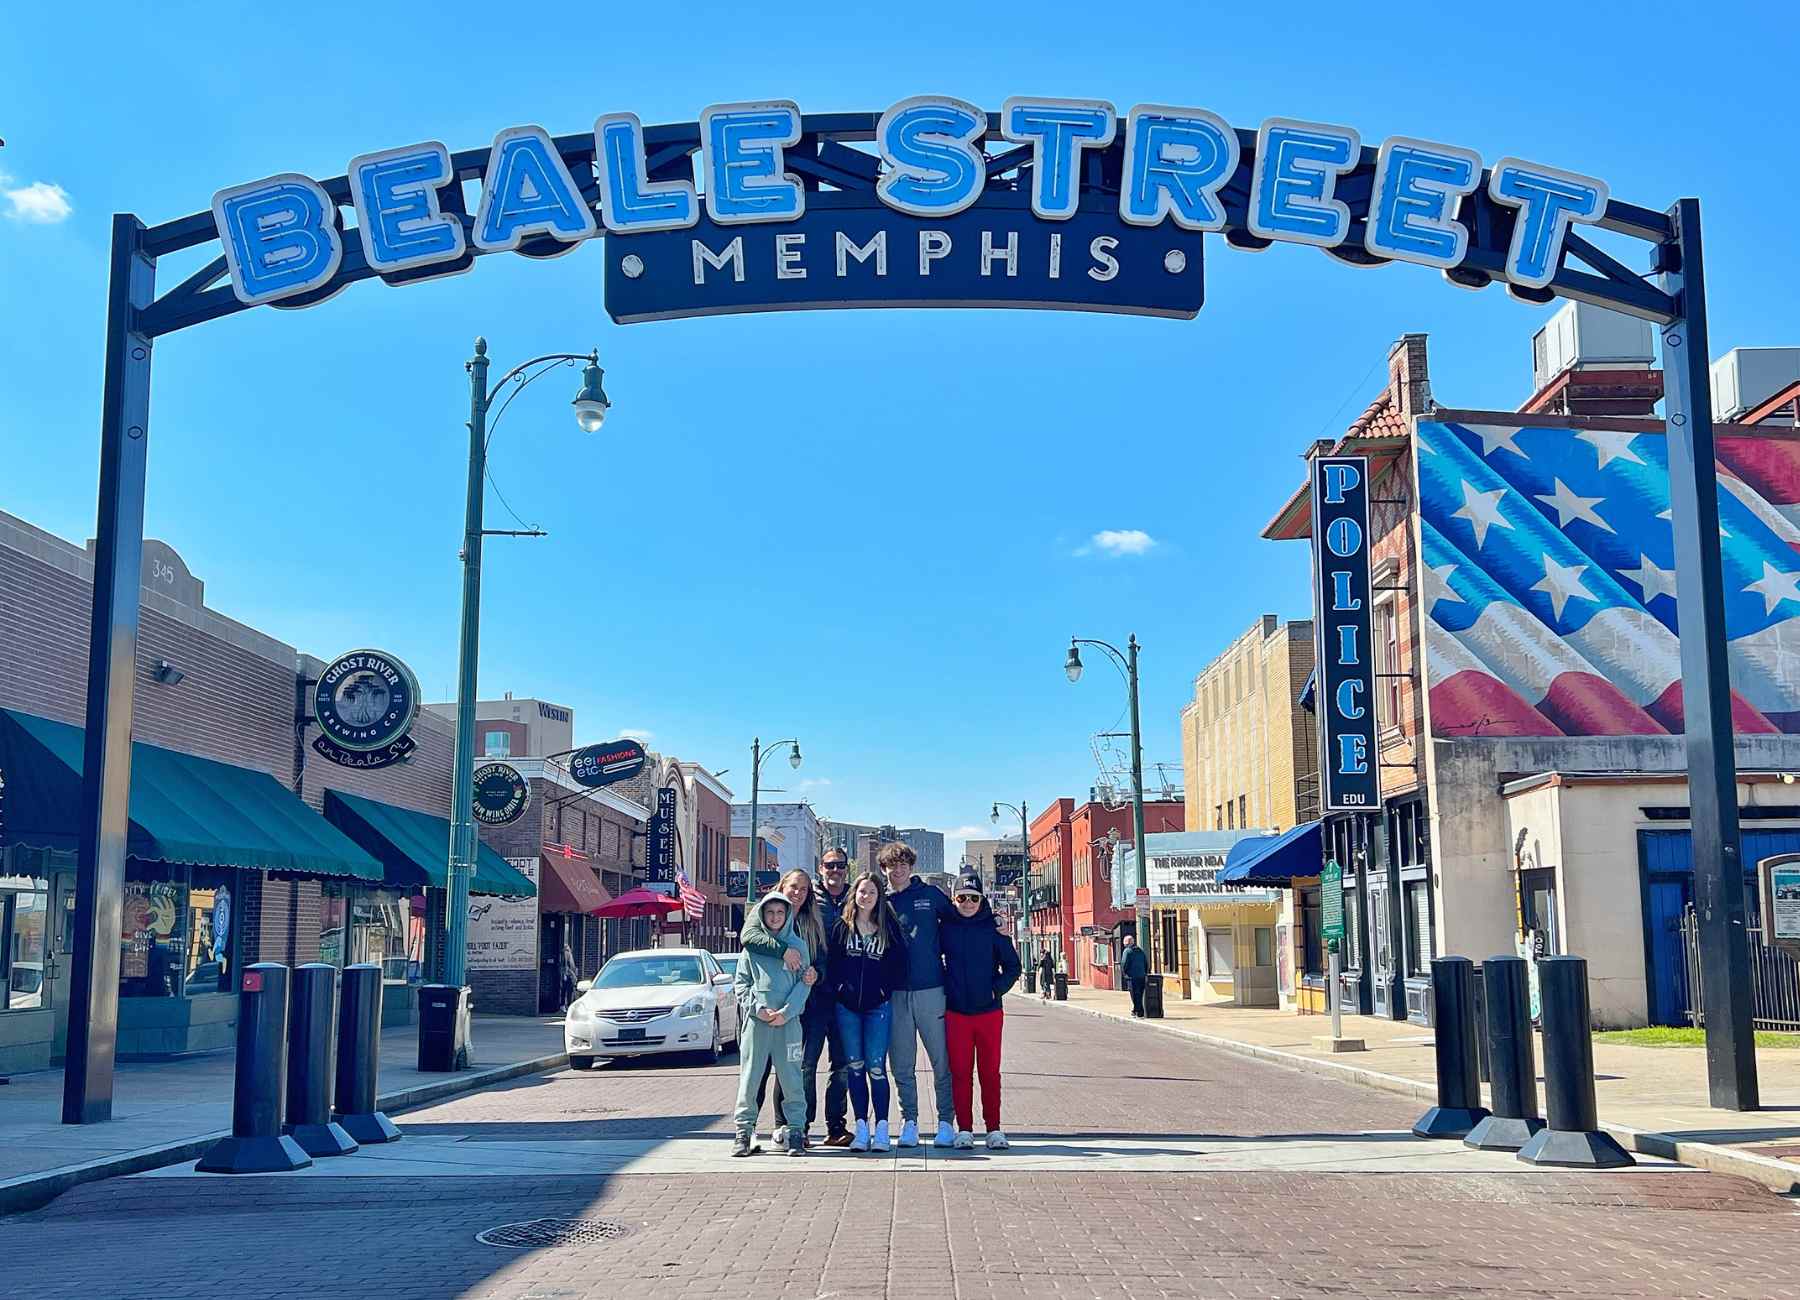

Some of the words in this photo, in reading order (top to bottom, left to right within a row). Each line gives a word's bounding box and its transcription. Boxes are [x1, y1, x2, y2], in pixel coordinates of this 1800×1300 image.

[212, 99, 806, 305] BEALE
[876, 95, 1610, 289] STREET
[692, 230, 1120, 284] MEMPHIS
[152, 558, 175, 585] 345
[1323, 465, 1368, 774] POLICE
[326, 657, 365, 684] GHOST
[366, 658, 399, 686] RIVER
[323, 711, 377, 739] BREWING
[597, 749, 637, 764] FASHIONS
[1343, 793, 1366, 805] EDU
[657, 792, 671, 881] MUSEUM
[1153, 857, 1170, 869] THE
[1171, 855, 1203, 868] RINGER
[1158, 883, 1176, 895] THE
